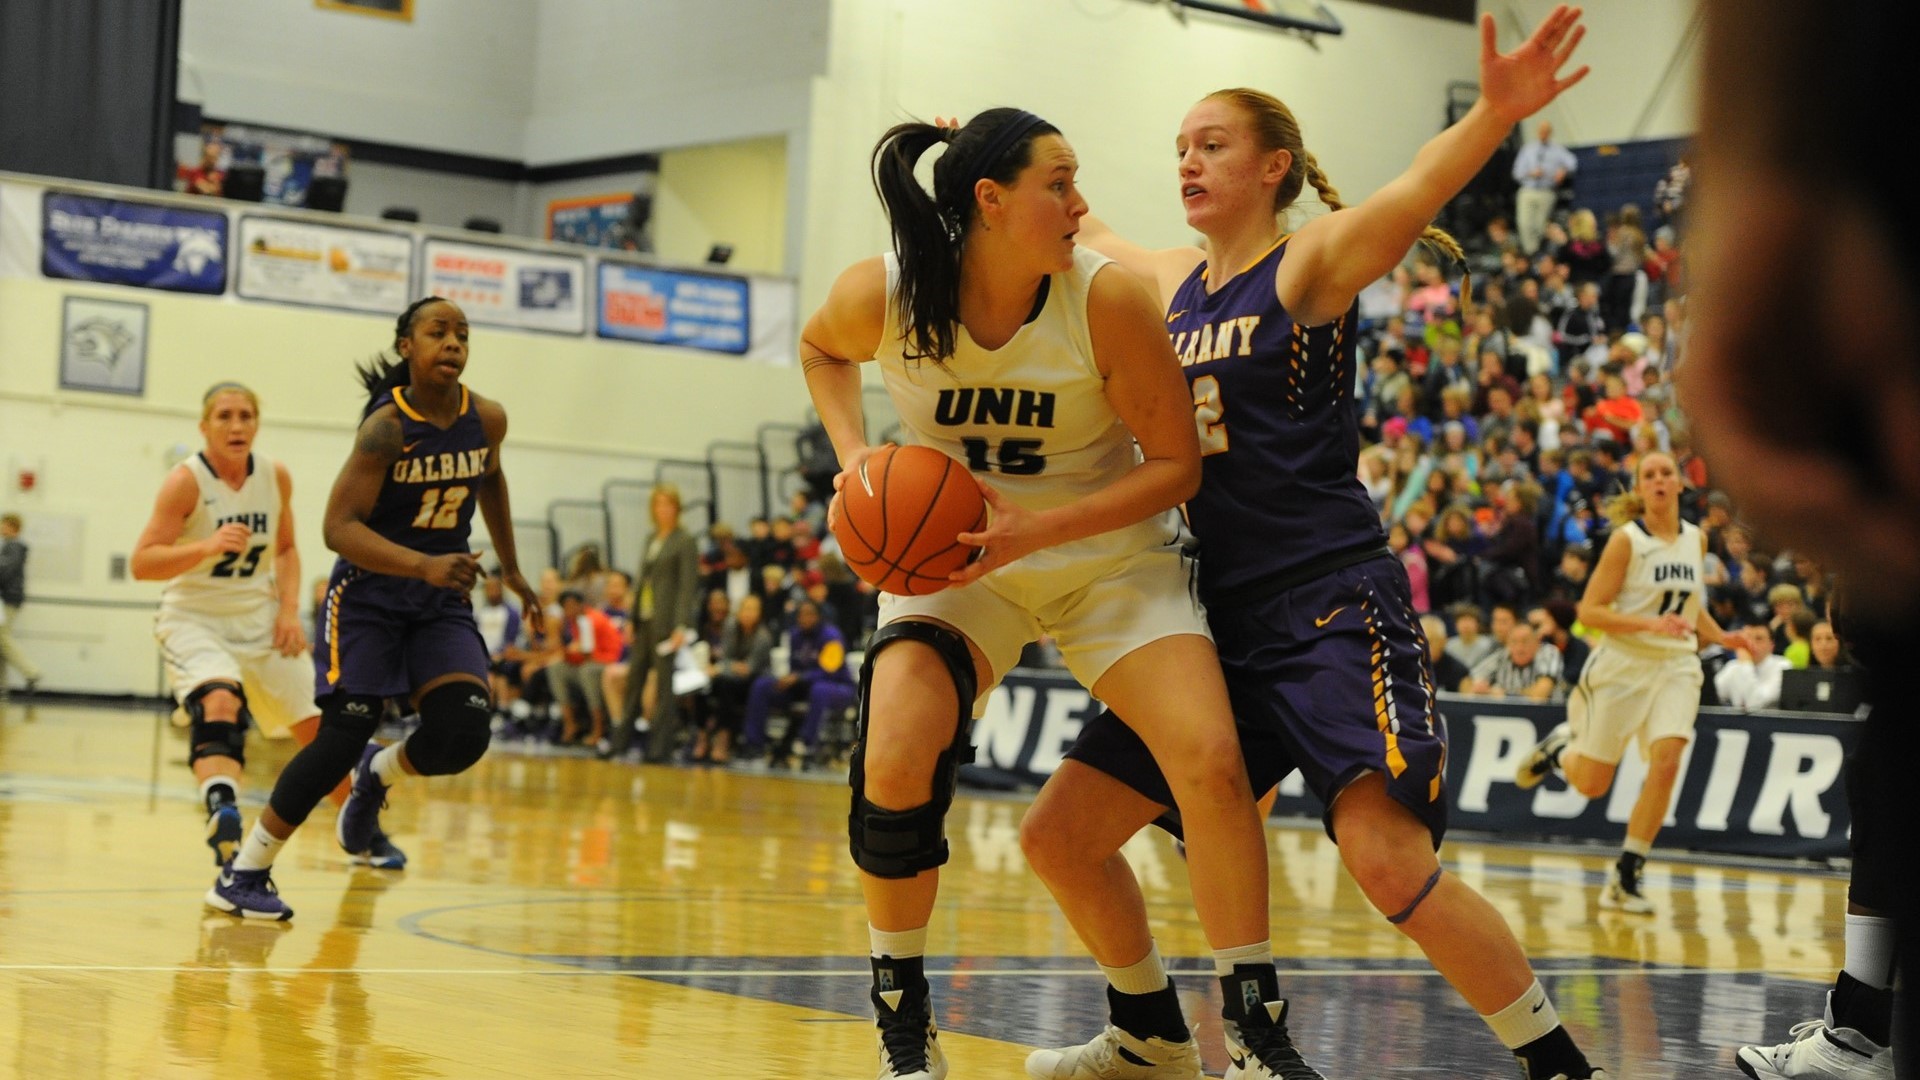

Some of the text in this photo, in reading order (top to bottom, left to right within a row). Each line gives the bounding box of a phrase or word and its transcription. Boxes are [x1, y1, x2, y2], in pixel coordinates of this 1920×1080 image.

[1169, 316, 1261, 367] LBANY
[934, 388, 1056, 428] UNH
[962, 436, 1047, 474] 15
[411, 485, 470, 529] 12
[210, 545, 268, 577] 25
[1654, 564, 1695, 581] UNH
[970, 684, 1108, 776] NE
